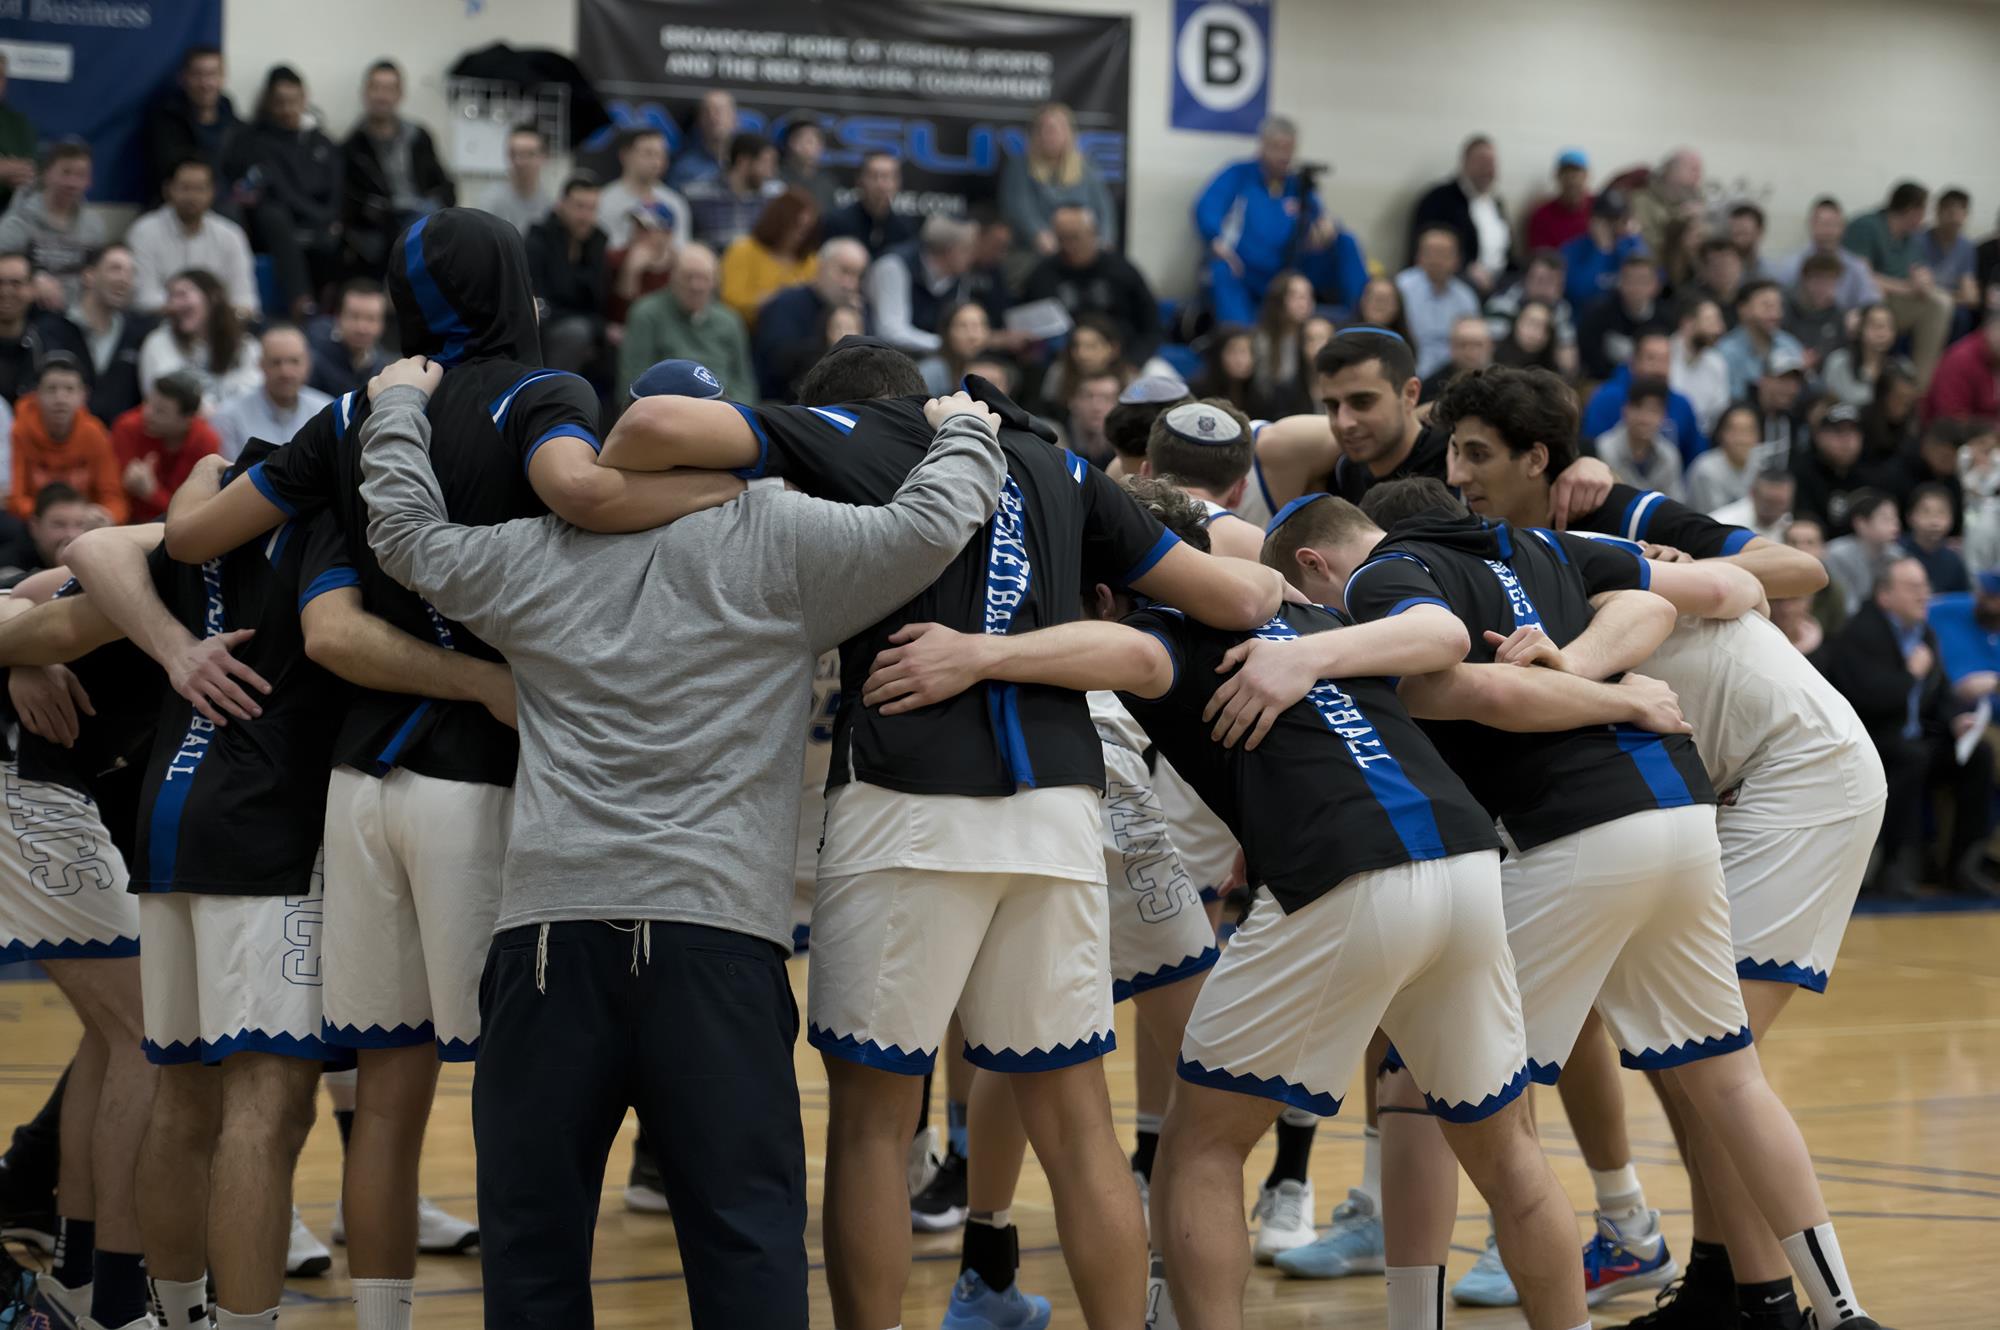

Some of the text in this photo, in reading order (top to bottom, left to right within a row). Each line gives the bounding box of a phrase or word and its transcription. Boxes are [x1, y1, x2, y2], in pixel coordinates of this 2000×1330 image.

[660, 26, 786, 56] BROADCAST
[787, 36, 848, 61] HOME
[850, 38, 881, 64] OF
[1204, 23, 1243, 86] B
[665, 53, 715, 78] AND
[717, 57, 757, 81] THE
[917, 71, 1051, 98] TOURNAMENT
